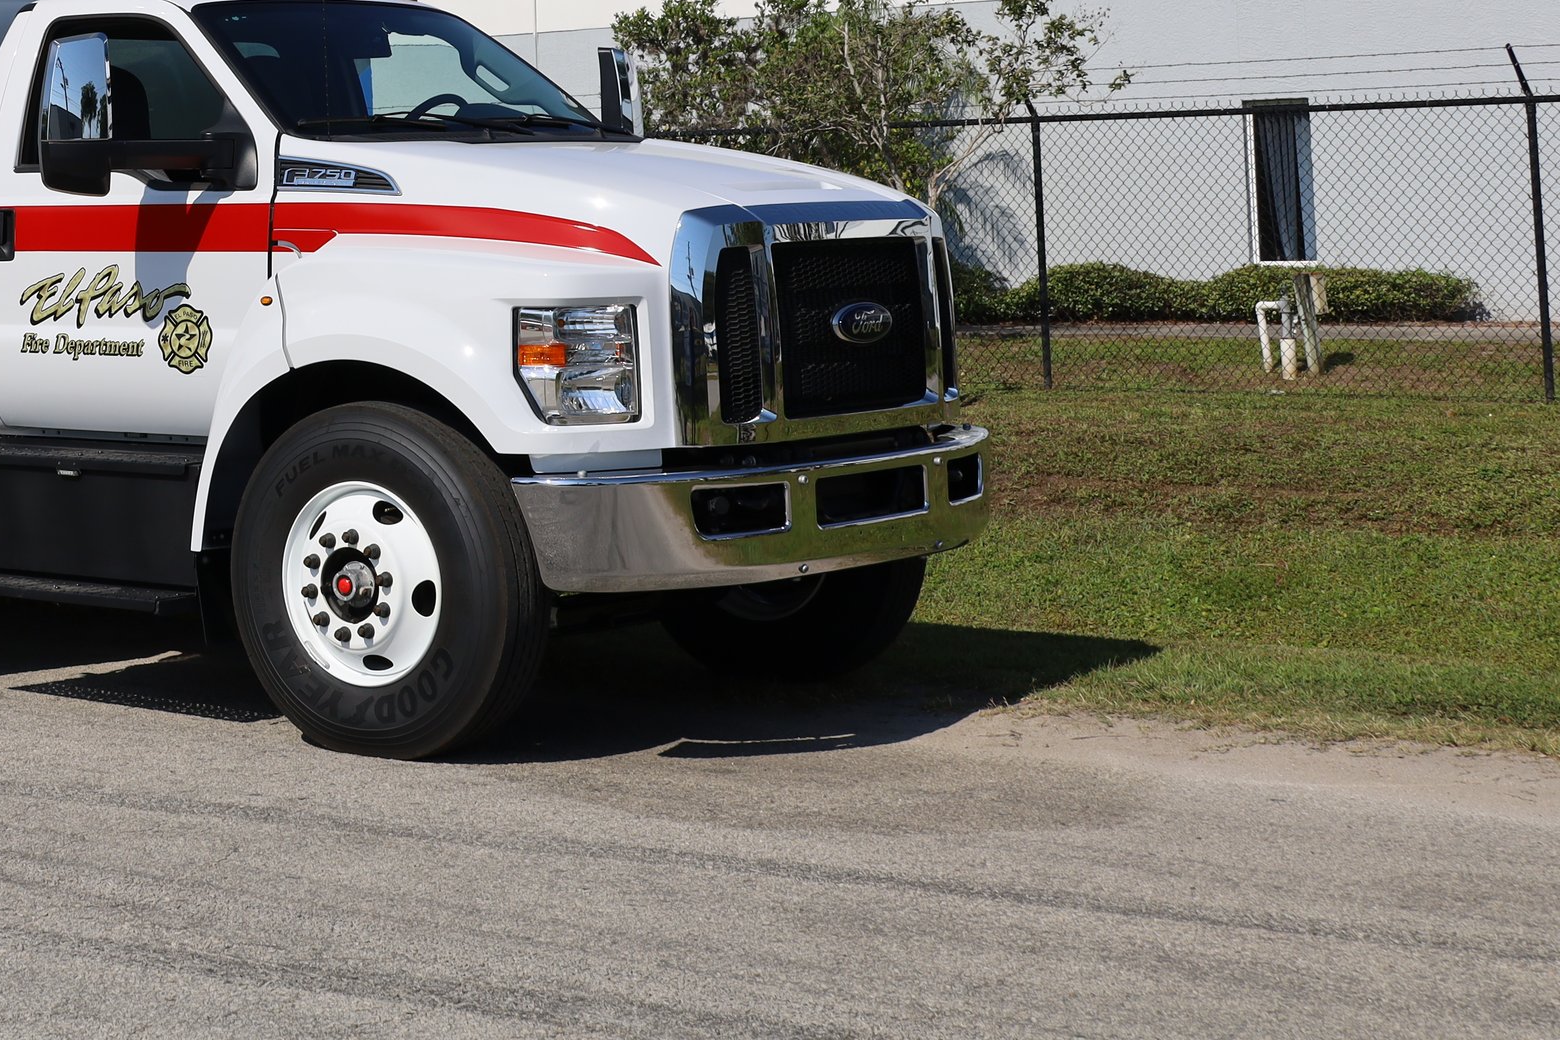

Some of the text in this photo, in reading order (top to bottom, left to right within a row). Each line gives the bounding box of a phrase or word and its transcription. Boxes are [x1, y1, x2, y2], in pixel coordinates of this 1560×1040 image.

[20, 264, 190, 329] El Paso
[182, 310, 198, 320] PASO
[852, 310, 883, 335] Ford
[21, 333, 145, 360] Fire Department
[274, 444, 385, 499] FUEL MAX
[262, 617, 454, 727] GOODYEAR
